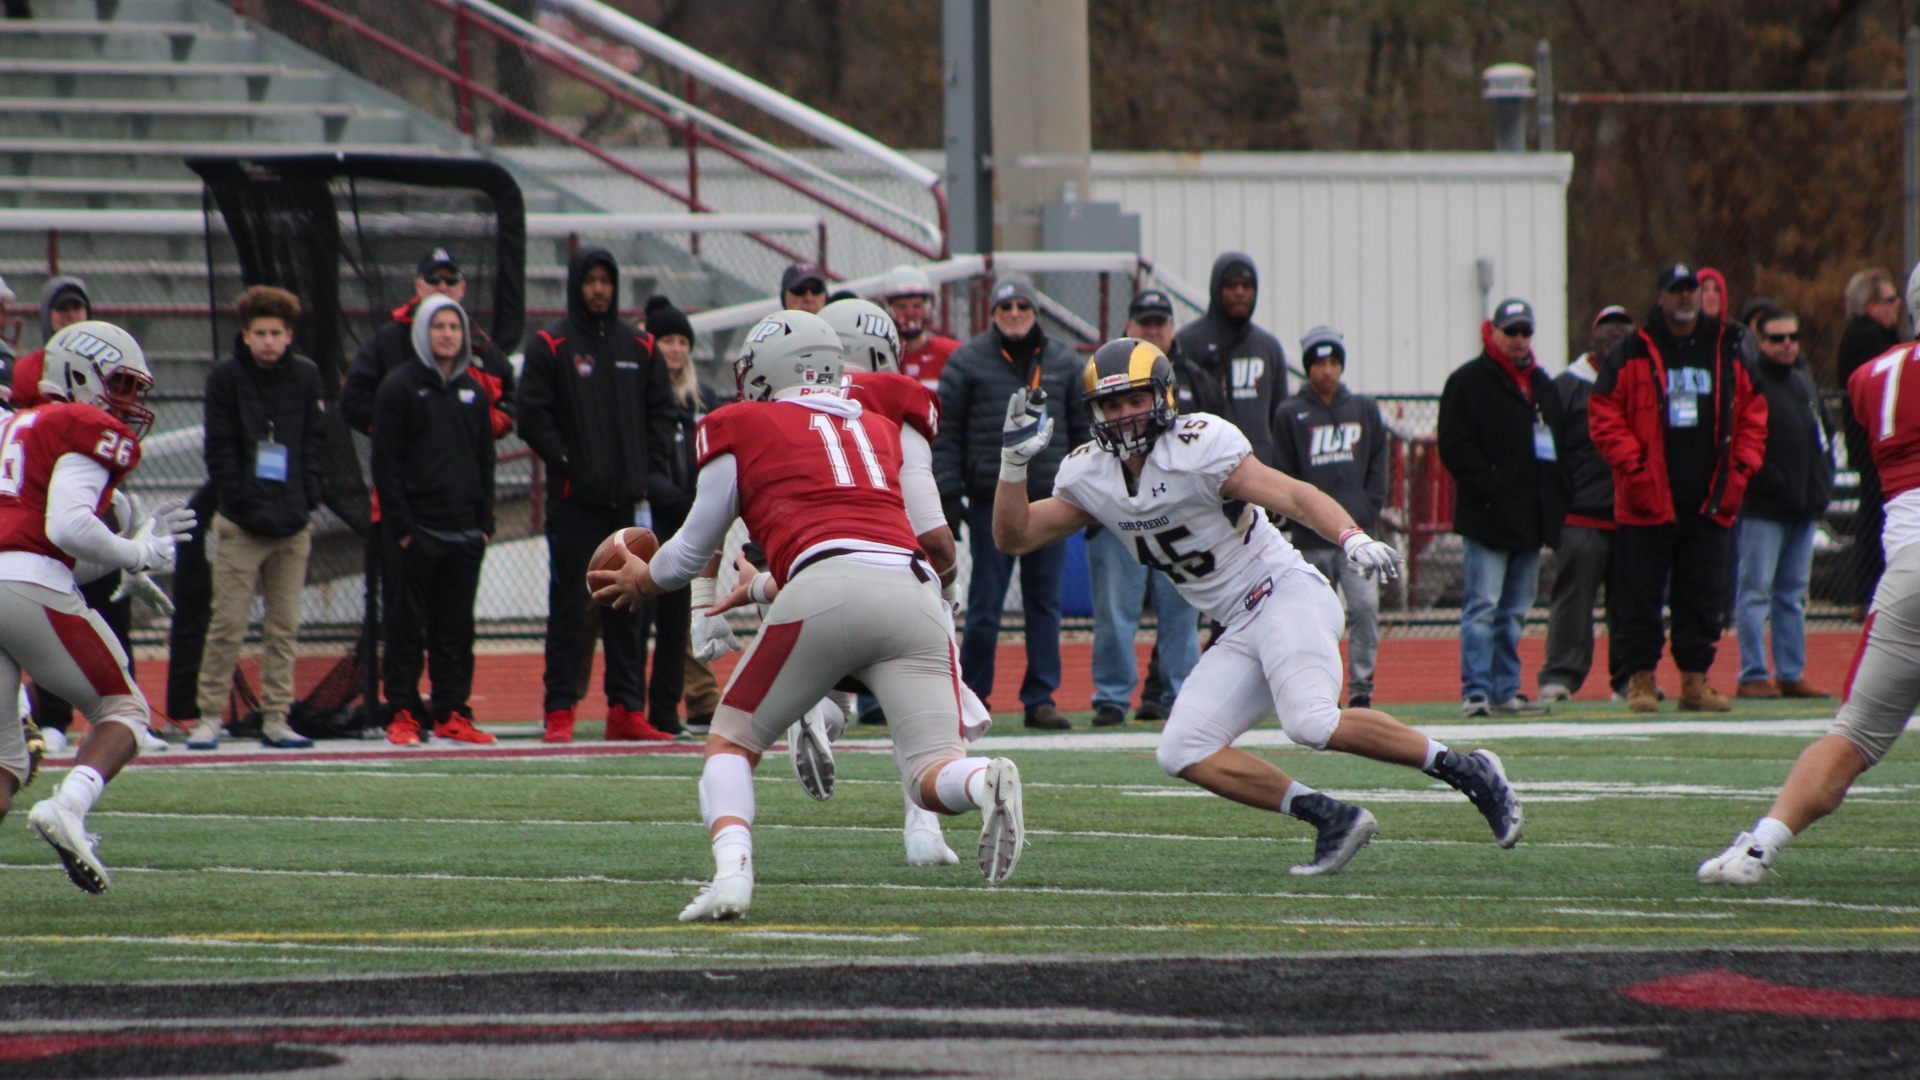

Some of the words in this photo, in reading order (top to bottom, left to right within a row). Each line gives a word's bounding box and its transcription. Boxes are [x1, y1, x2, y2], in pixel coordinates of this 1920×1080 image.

[64, 331, 123, 365] IUP
[1103, 374, 1122, 385] Riddell
[1871, 345, 1920, 441] 7
[94, 429, 134, 467] 26
[1177, 419, 1208, 446] 45
[1310, 422, 1362, 455] IUP
[809, 412, 891, 491] 11
[1118, 515, 1170, 532] SHEPHERD
[1134, 524, 1216, 584] 45
